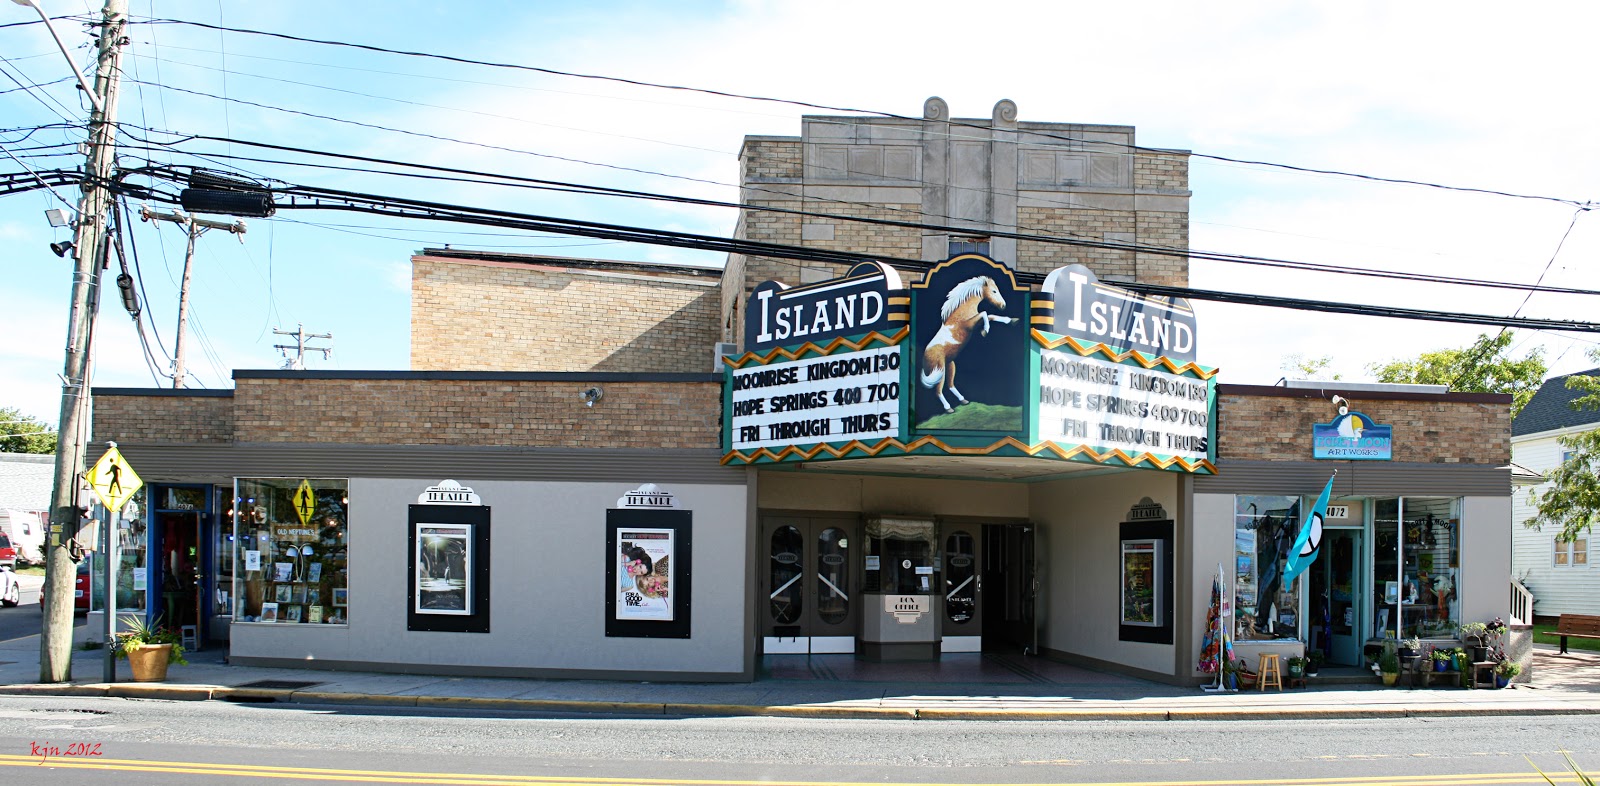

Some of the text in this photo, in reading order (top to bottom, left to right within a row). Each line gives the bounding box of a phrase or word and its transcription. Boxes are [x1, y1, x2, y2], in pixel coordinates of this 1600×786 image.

[757, 289, 884, 344] ISLAND
[1068, 272, 1193, 354] ISLAND
[733, 352, 900, 391] MOONRISE KINGDOM 130
[1040, 354, 1208, 402] MOONRISE KINGDOM 130
[733, 382, 899, 417] HOPE SPRINGS 400 700
[1040, 385, 1208, 427] HOPE SPRINGS 400 700
[740, 412, 891, 443] FRI THROUGH THURS
[1062, 418, 1208, 452] FRI THROUGH THURS
[1358, 437, 1390, 448] MOON
[428, 492, 472, 501] THEATRE
[627, 496, 673, 505] THEATRE
[1326, 507, 1345, 517] 4072
